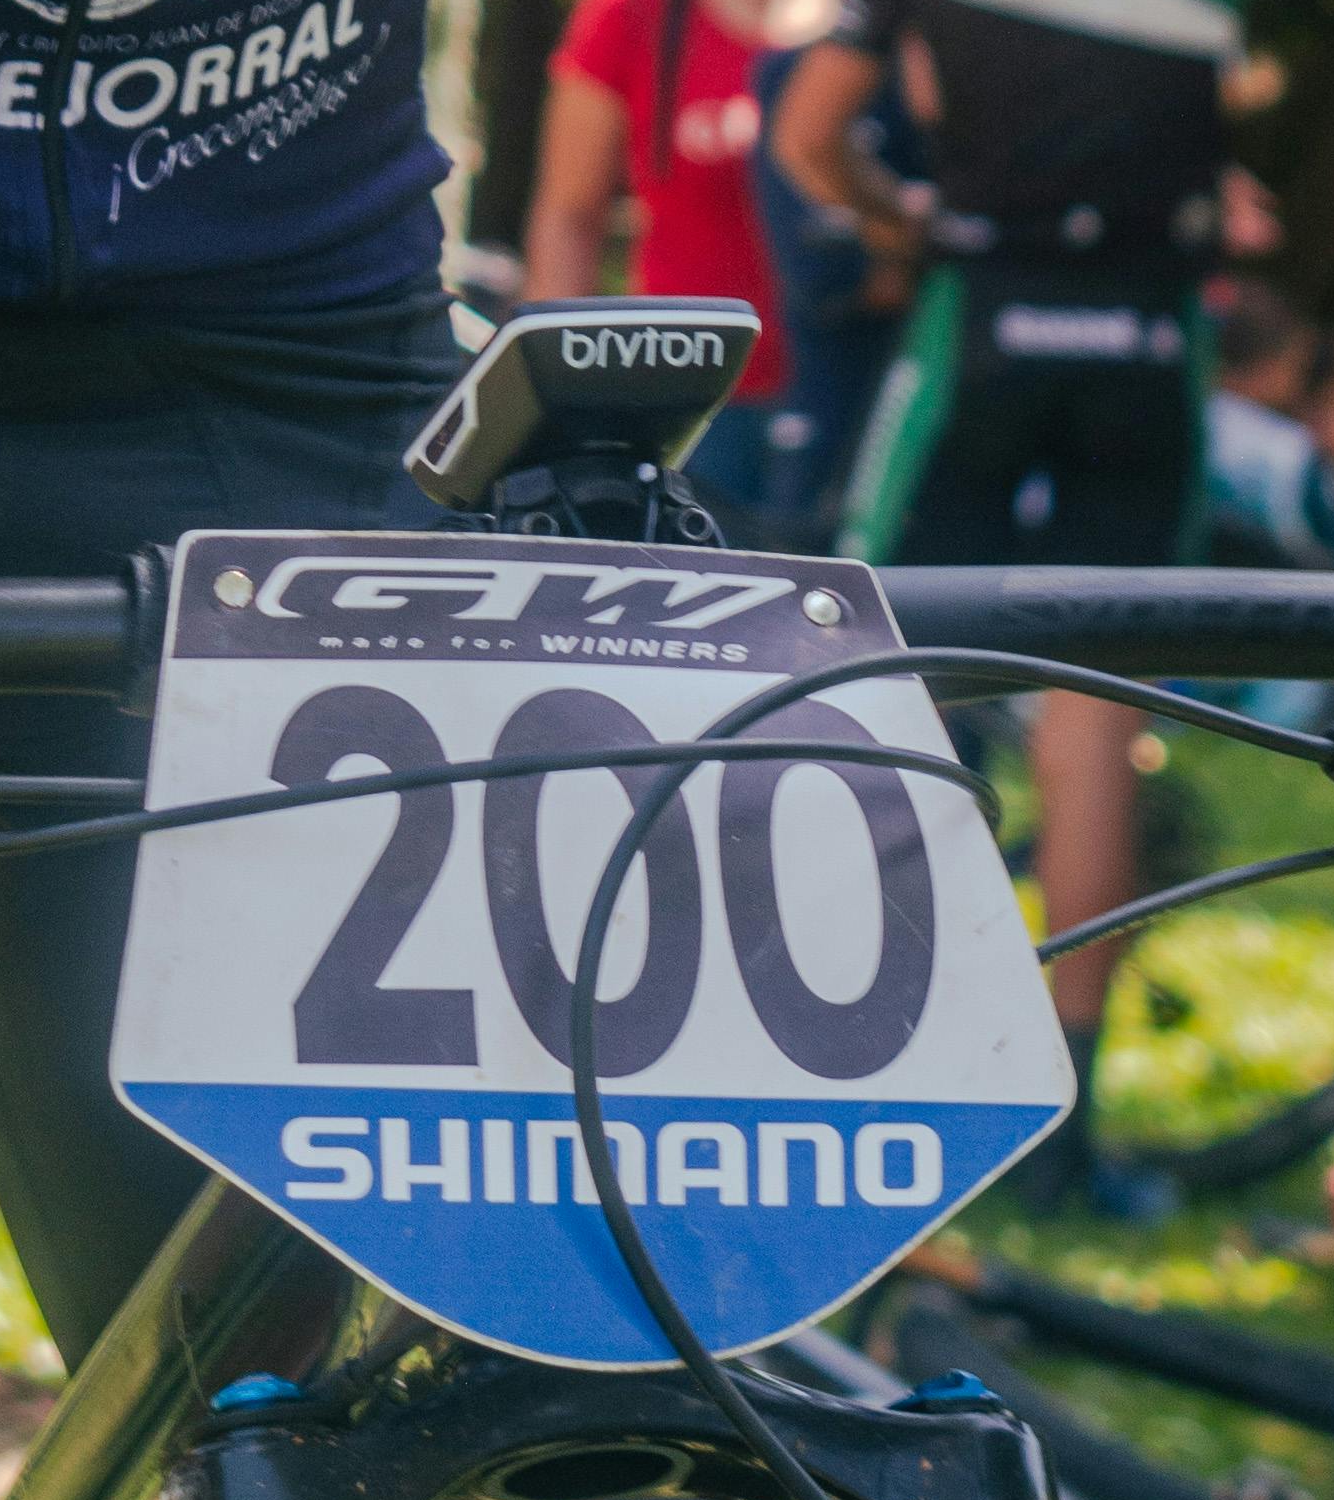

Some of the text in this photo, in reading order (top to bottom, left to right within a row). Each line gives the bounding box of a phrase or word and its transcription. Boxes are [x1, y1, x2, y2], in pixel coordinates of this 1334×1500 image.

[561, 325, 725, 370] bryton
[318, 634, 750, 663] made for WINNERS
[269, 684, 936, 1080] 200
[280, 1115, 943, 1207] SHIMANO
